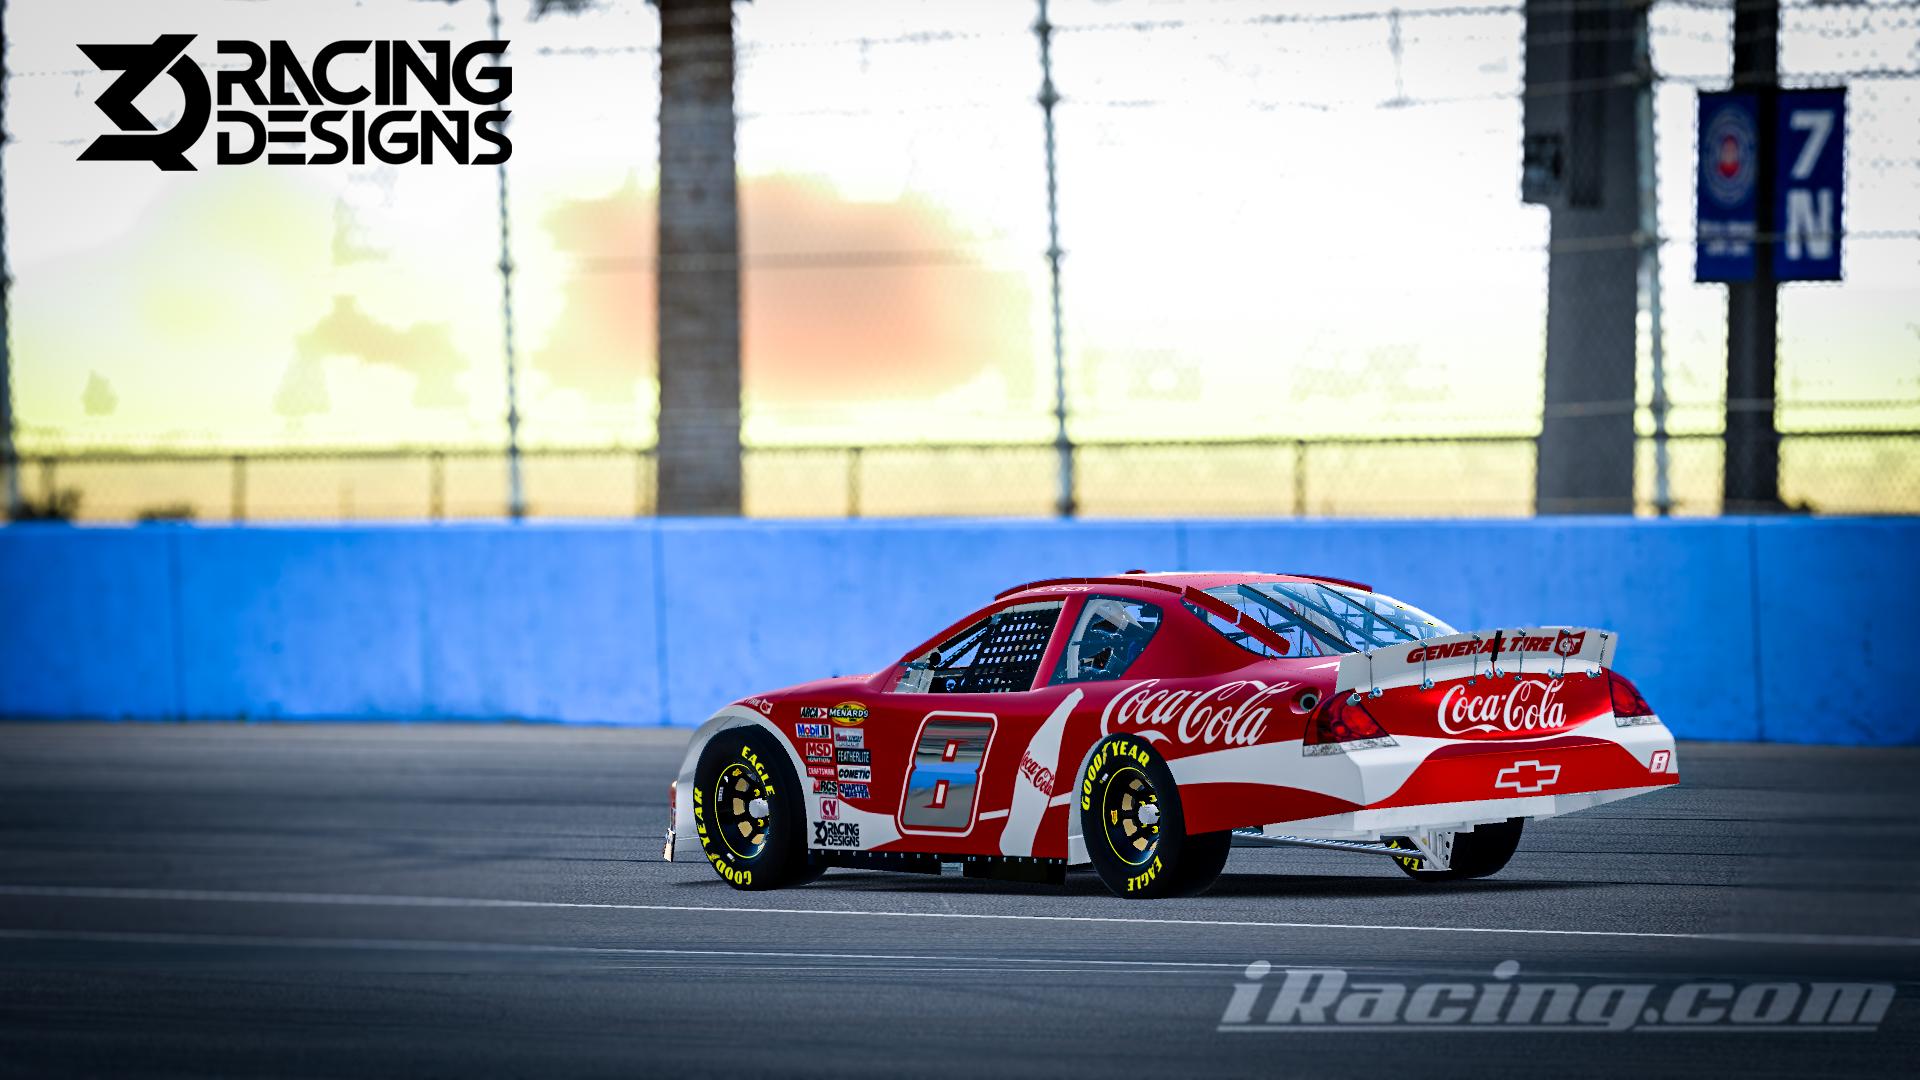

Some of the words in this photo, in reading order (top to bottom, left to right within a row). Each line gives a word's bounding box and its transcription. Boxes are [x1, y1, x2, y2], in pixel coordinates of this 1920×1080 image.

[1789, 110, 1834, 180] 7
[1785, 188, 1833, 260] N
[1407, 638, 1507, 663] GENERAL
[1509, 636, 1555, 652] TIRE
[801, 707, 819, 718] ARCA
[829, 708, 868, 718] MENARDS
[1100, 679, 1294, 745] Coca-Cola
[1437, 679, 1567, 735] Coca-Cola
[797, 724, 819, 736] Mobil
[807, 743, 832, 757] MSD
[837, 750, 870, 763] FEATHERLITE
[1649, 750, 1670, 773] 8
[741, 745, 775, 796] EAGLE
[838, 769, 871, 780] COMETIC
[899, 712, 997, 836] 8
[820, 781, 838, 793] RCS
[822, 800, 837, 816] CV
[827, 822, 860, 836] RACING
[827, 835, 860, 847] DESIGNS
[1127, 855, 1163, 892] EAGLE
